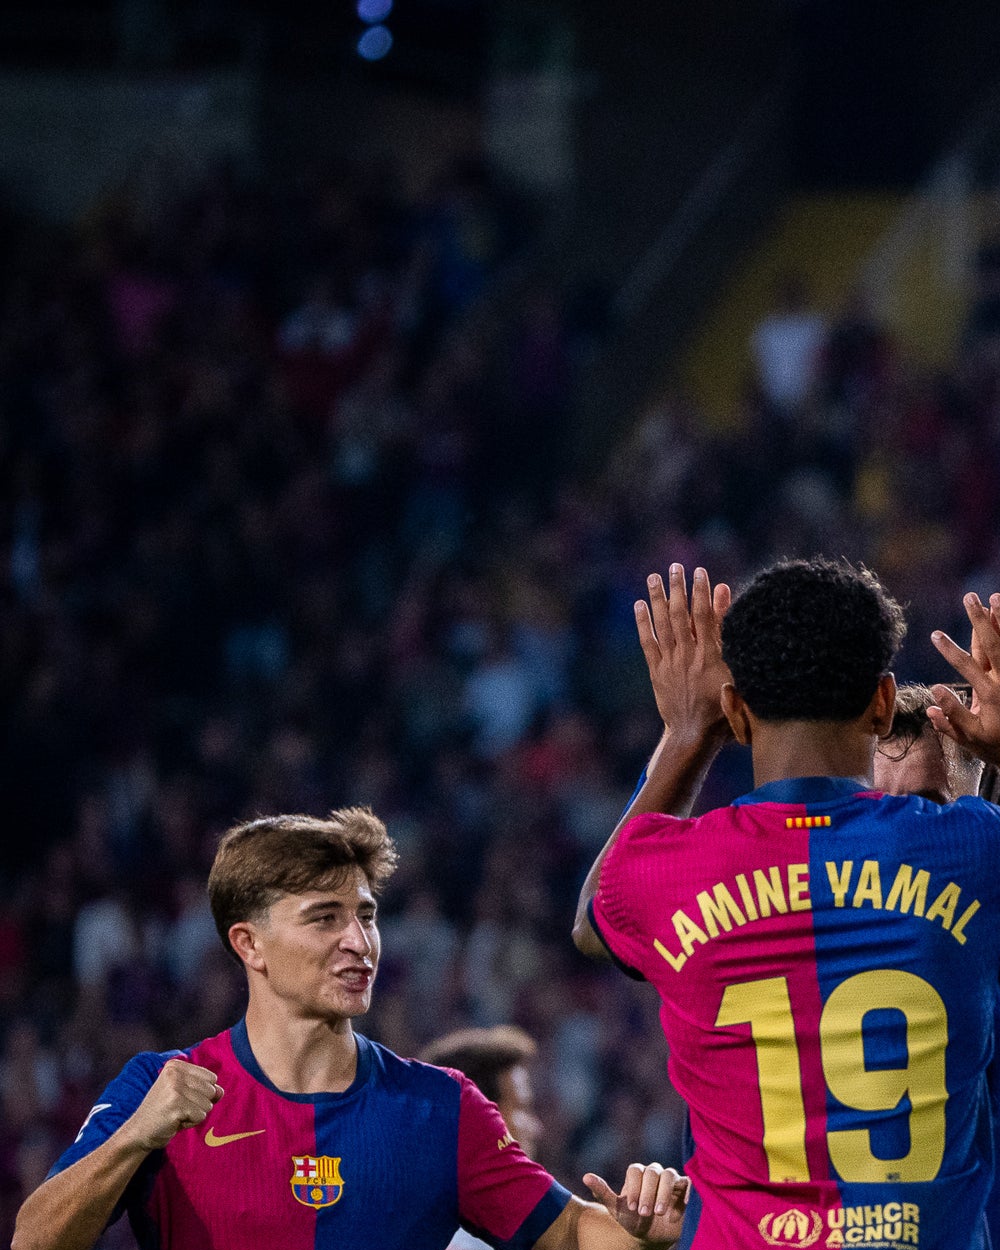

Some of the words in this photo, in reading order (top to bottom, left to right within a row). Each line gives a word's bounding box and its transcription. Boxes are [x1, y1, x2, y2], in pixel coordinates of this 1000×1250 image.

[653, 864, 812, 973] LAMINE
[825, 860, 981, 946] YAMAL
[715, 968, 949, 1183] 19
[306, 1177, 327, 1185] FCB
[828, 1202, 919, 1229] UNHCR
[826, 1222, 919, 1245] ACNUR
